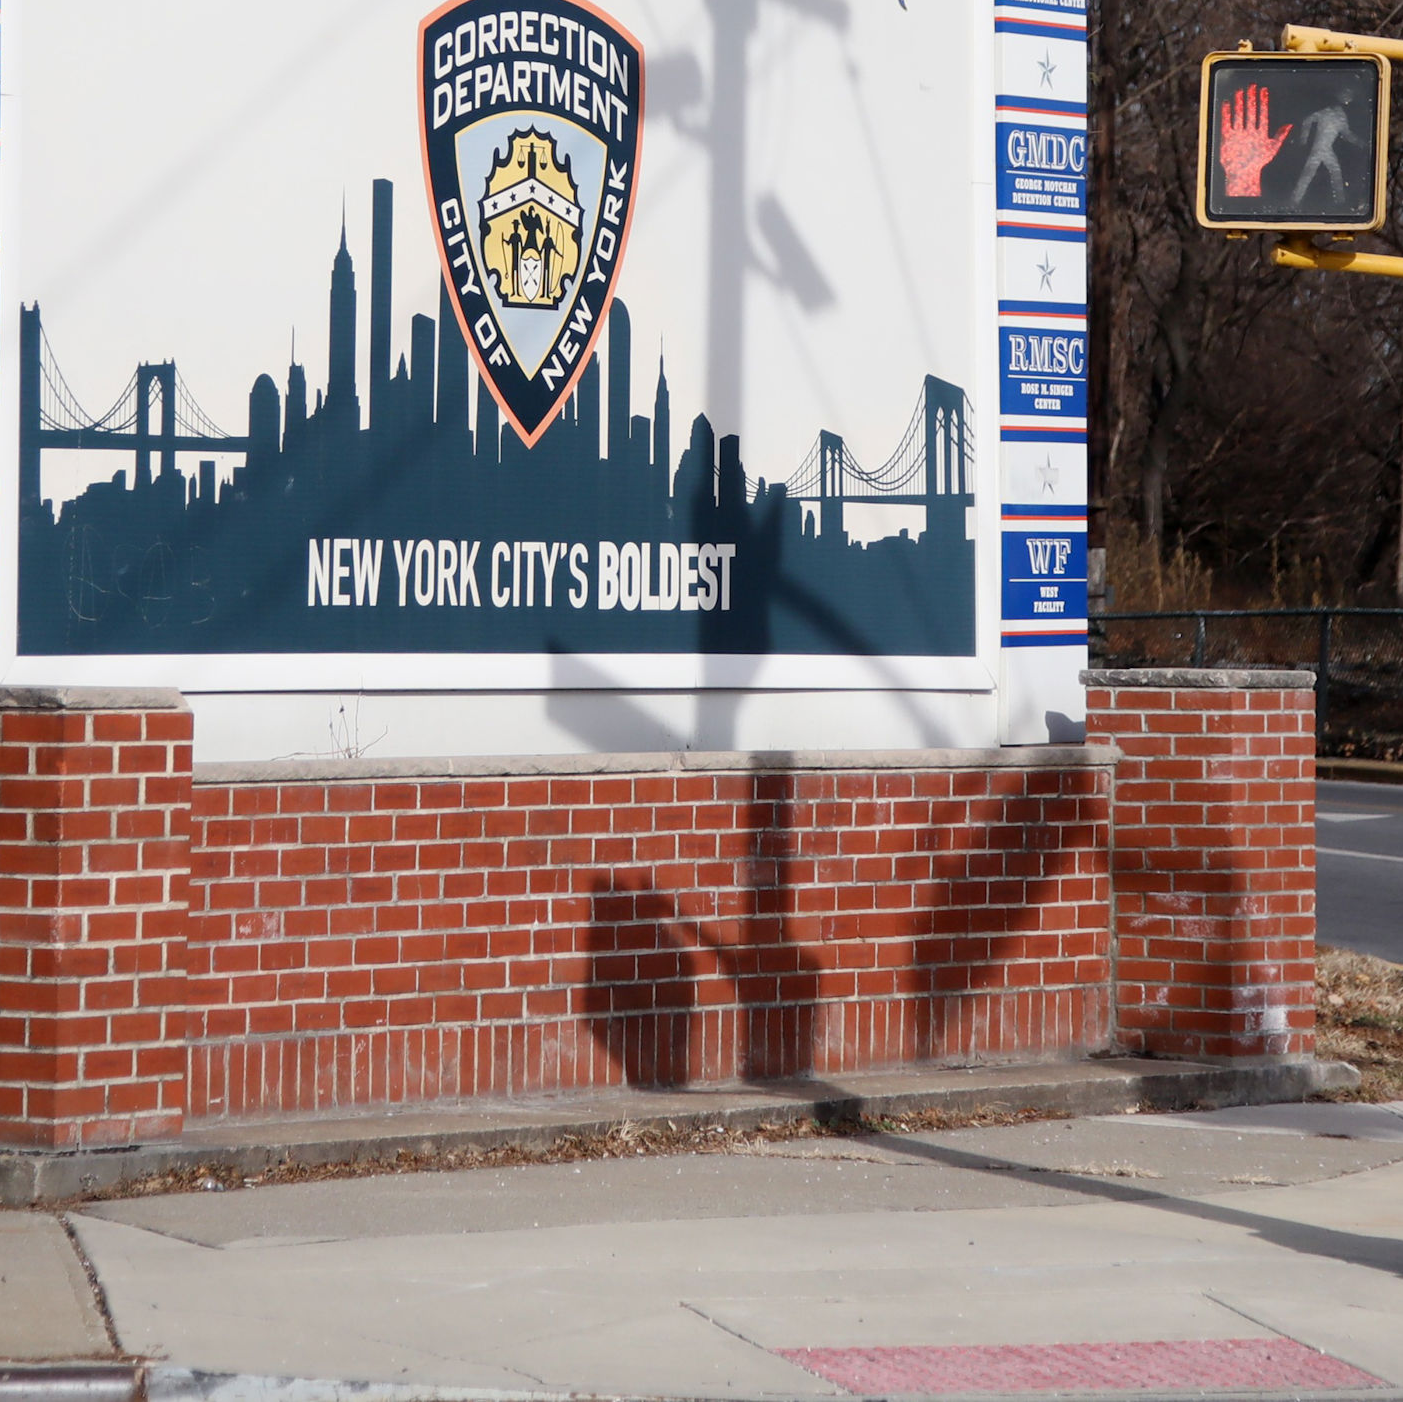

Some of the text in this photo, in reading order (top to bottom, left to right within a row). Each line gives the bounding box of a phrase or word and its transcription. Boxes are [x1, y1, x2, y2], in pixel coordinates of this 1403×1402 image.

[433, 10, 629, 96] CORRECTION
[432, 60, 629, 142] DEPARTMENT
[1007, 129, 1085, 173] GMDC
[1012, 192, 1080, 209] DETENTION CENTER
[1015, 177, 1043, 191] GEORGE
[440, 157, 629, 392] CITY OF NEW YORK
[1008, 334, 1084, 375] RMSC
[1020, 382, 1039, 395] ROSE
[1034, 398, 1061, 410] CENTER
[307, 538, 736, 612] NEW YORK CITY'S BOLDEST
[1026, 538, 1072, 575] WF
[1033, 601, 1065, 613] FACILITY
[1039, 586, 1059, 598] WEST
